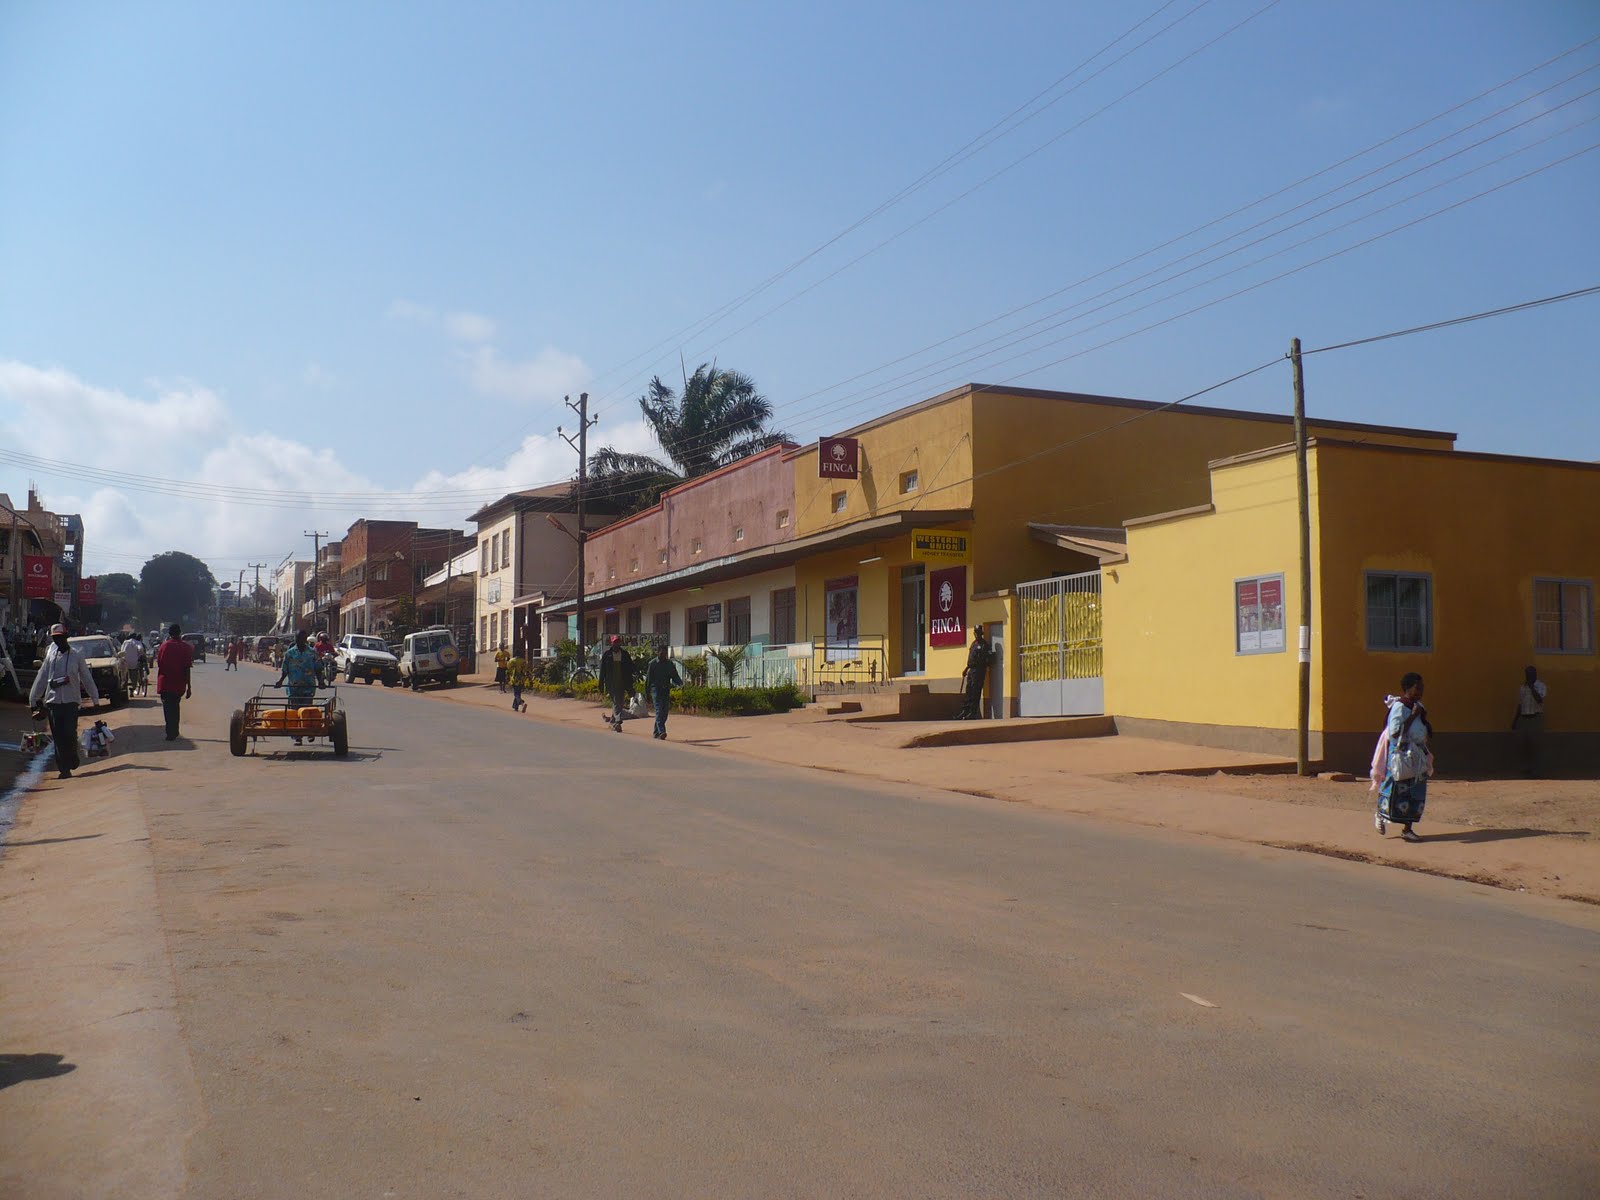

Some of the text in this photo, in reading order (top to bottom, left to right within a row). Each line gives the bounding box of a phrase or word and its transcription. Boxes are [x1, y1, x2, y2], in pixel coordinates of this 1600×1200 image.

[823, 462, 854, 473] FINCA
[916, 535, 958, 544] WESTERN
[929, 542, 958, 551] UNION
[931, 616, 961, 635] FINCA
